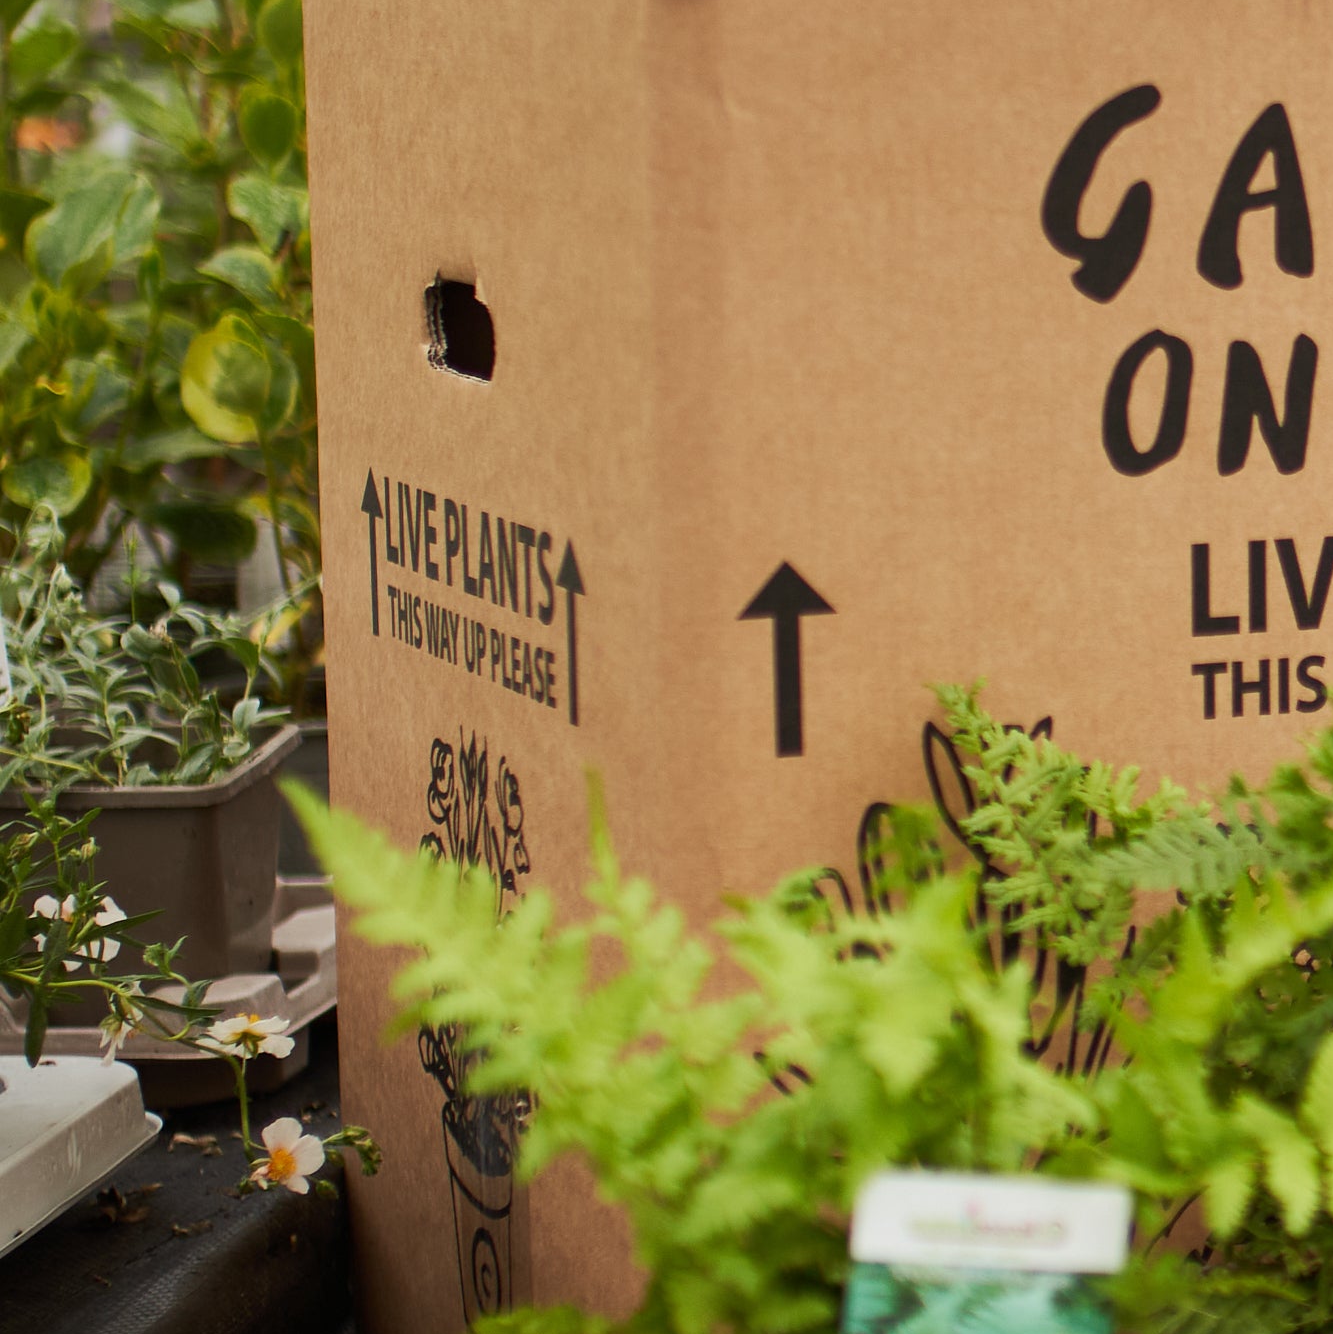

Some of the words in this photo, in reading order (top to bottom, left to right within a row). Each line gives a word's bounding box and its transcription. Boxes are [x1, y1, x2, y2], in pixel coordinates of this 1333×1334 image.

[1102, 328, 1319, 477] ON
[384, 476, 440, 582] LIVE
[444, 498, 556, 626] PLANTS
[387, 584, 422, 650] THIS
[424, 600, 460, 666] WAY
[464, 616, 487, 677] UP
[491, 628, 557, 709] PLEASE
[1191, 654, 1328, 720] THIS
